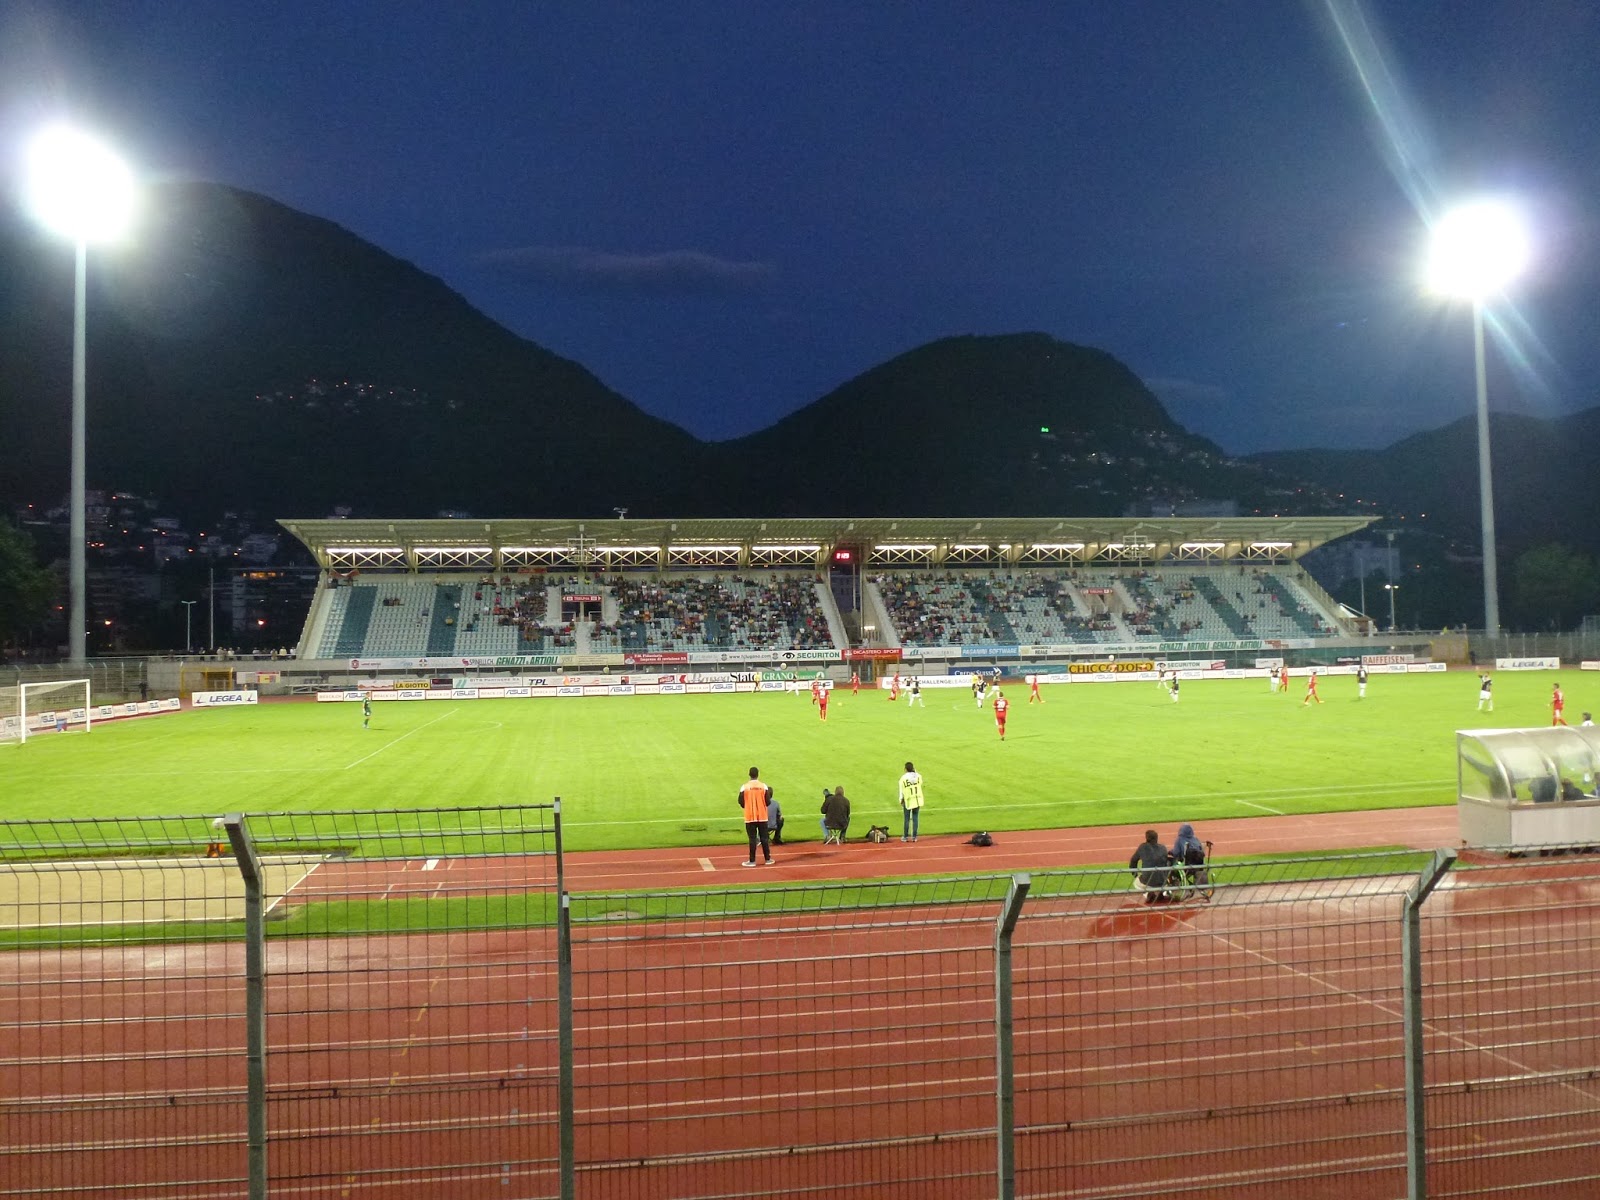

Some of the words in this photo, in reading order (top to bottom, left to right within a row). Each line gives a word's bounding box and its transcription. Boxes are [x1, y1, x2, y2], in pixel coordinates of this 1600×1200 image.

[496, 656, 526, 666] GENAZZI
[530, 655, 558, 665] ARTIOLI
[1363, 655, 1405, 664] RAIFFEISEN
[763, 672, 794, 680] GRANO
[528, 678, 549, 686] TPL
[209, 694, 243, 703] LEGEA
